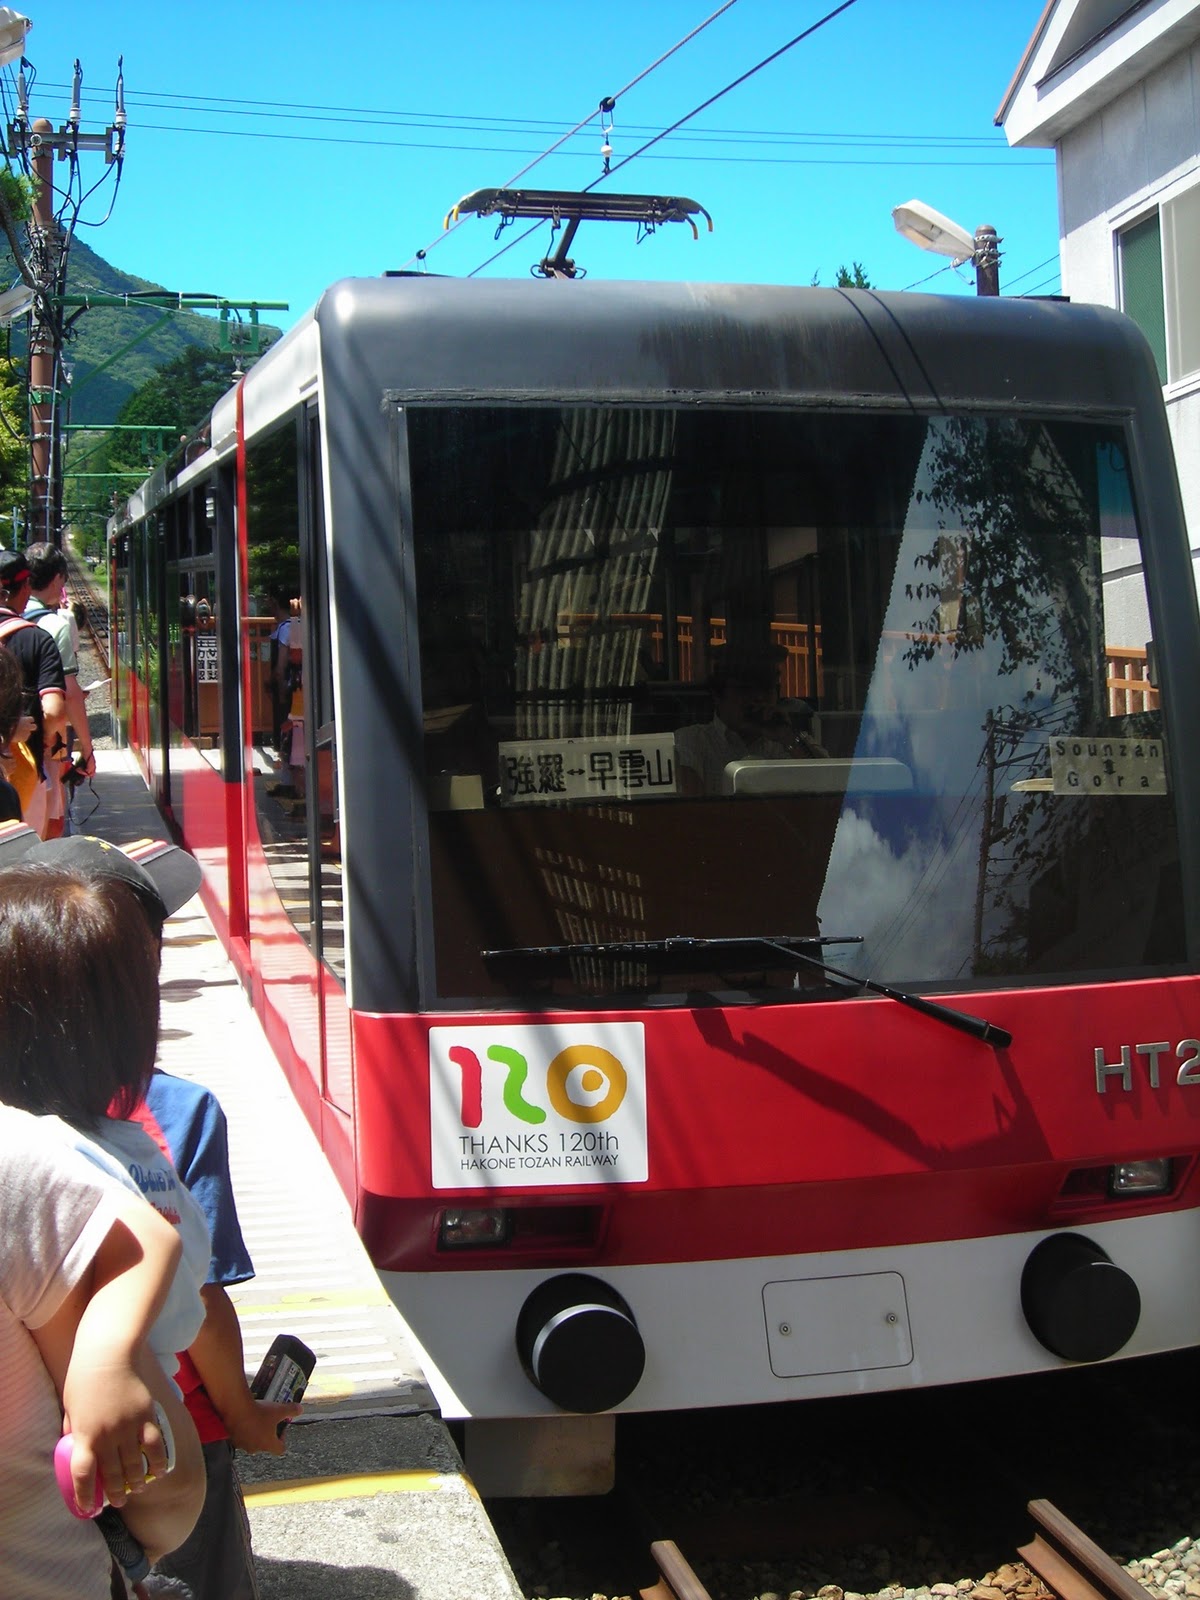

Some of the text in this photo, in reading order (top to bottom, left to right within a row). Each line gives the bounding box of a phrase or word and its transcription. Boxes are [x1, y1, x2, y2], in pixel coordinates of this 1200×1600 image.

[1055, 740, 1159, 758] Sounzan
[588, 749, 672, 790] 早雲山
[1067, 771, 1150, 788] Gora
[1094, 1038, 1200, 1094] HT2
[458, 1131, 619, 1155] THANKS 120th
[460, 1153, 619, 1170] HAKONE TOZAN RAILWAY
